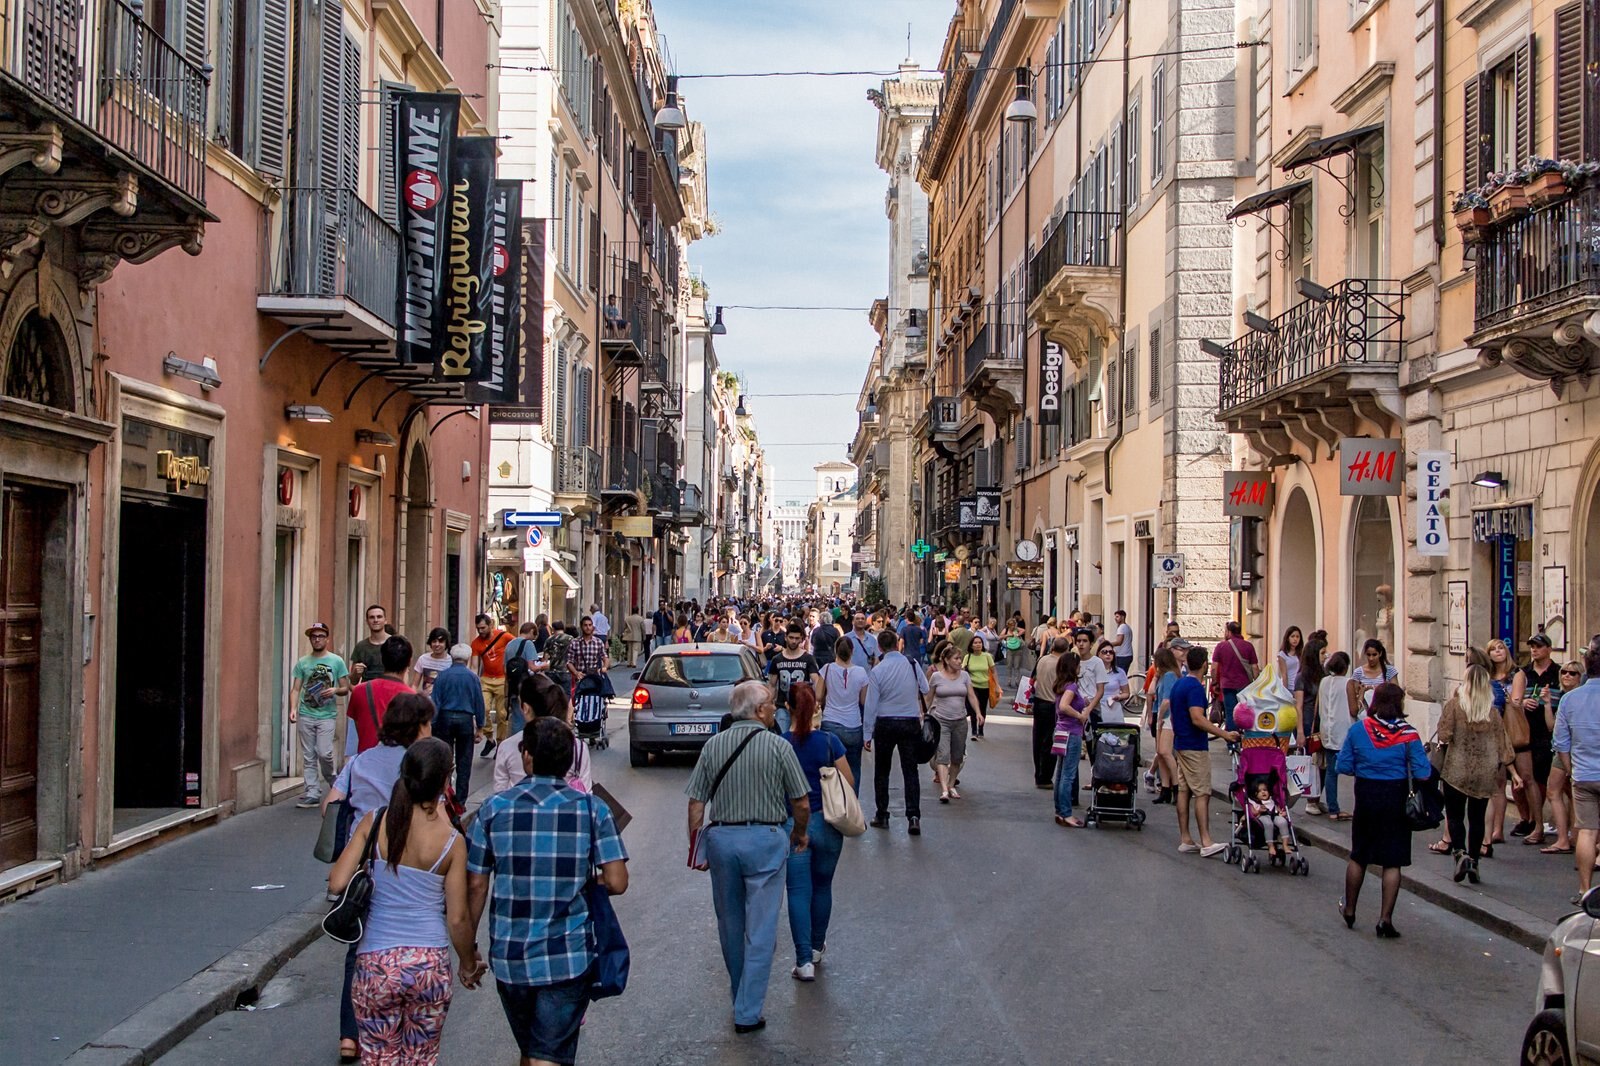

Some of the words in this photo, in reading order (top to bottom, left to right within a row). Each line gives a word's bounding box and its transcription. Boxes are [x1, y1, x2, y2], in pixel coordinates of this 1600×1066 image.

[404, 206, 435, 349] MURPHY
[1228, 480, 1267, 506] H&M
[1347, 450, 1397, 484] H&M
[1426, 459, 1442, 546] GELATO
[1473, 506, 1529, 544] GELATERIA
[1502, 533, 1514, 630] GELATI
